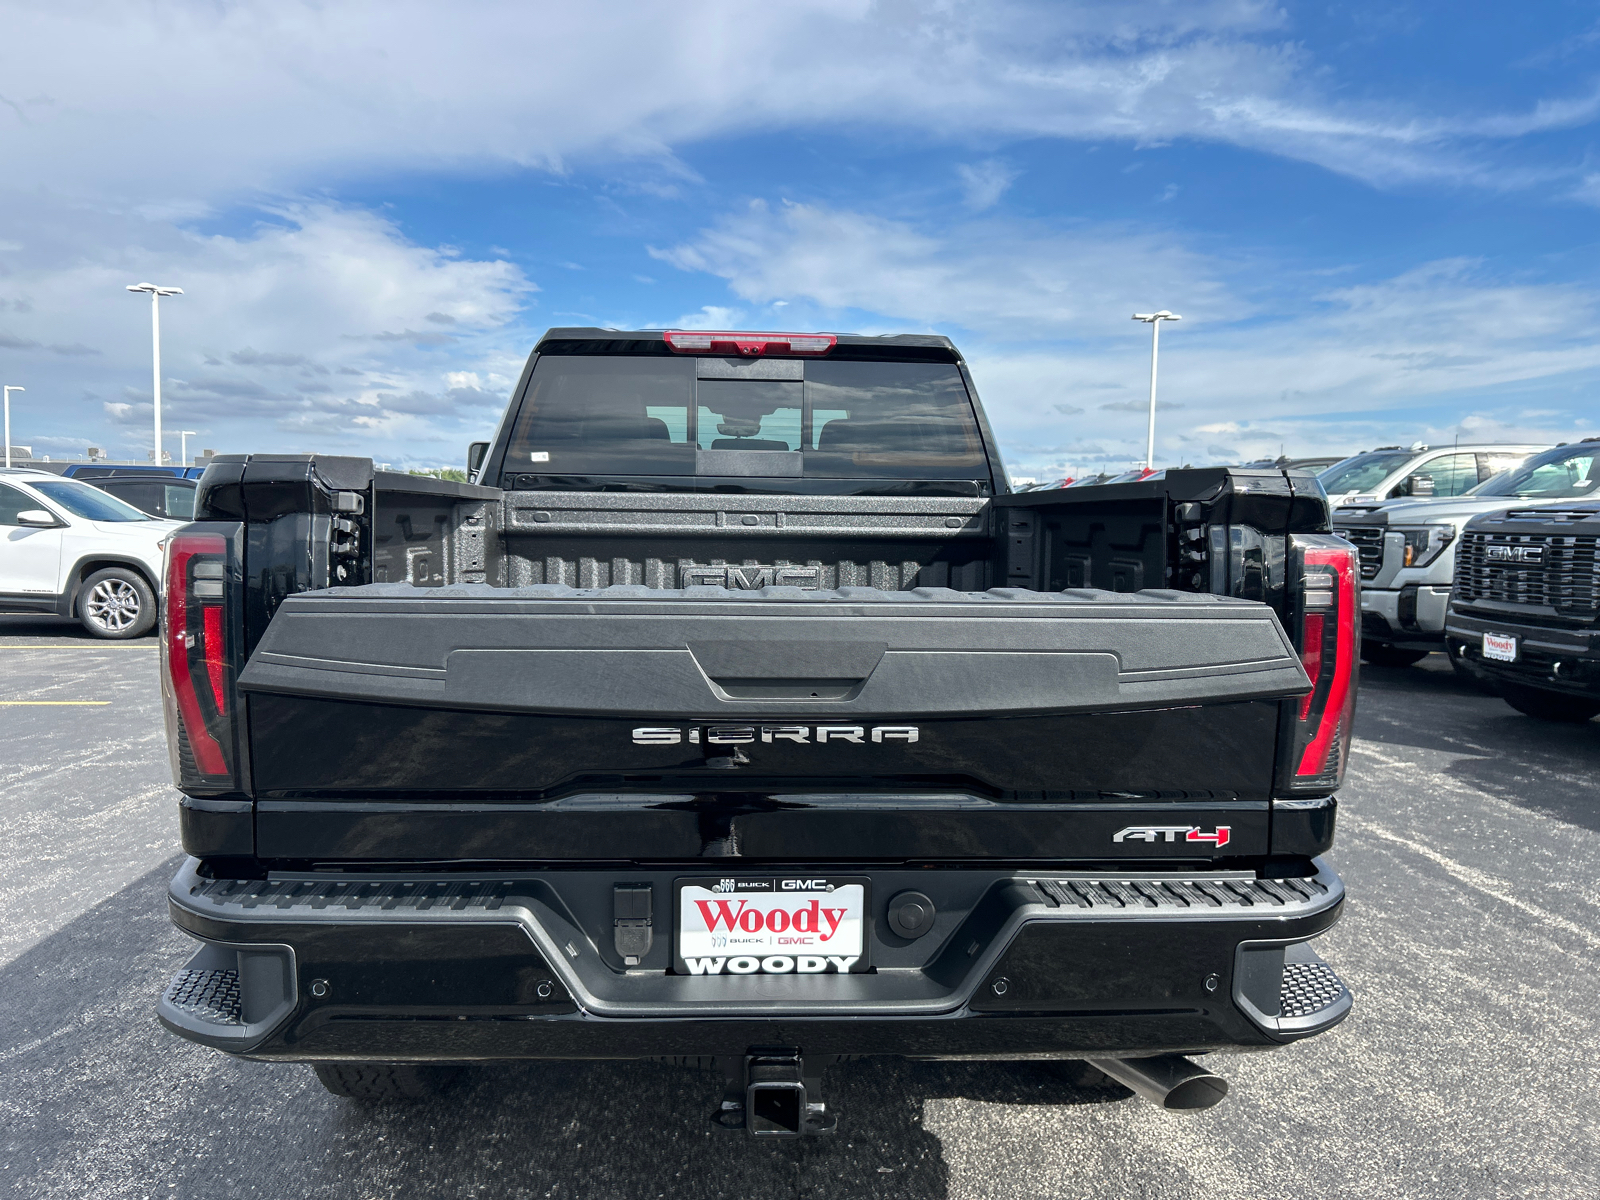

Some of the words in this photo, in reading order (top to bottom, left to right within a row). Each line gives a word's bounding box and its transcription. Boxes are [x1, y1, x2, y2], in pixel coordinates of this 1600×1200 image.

[1486, 546, 1542, 562] GMC
[683, 567, 818, 592] GMC
[1486, 636, 1514, 651] Woody
[632, 726, 919, 744] SIERRA
[1113, 826, 1232, 848] AT4
[781, 879, 827, 890] GMC
[693, 900, 848, 941] Woody
[777, 937, 814, 945] GMC
[684, 955, 860, 975] WOODY
